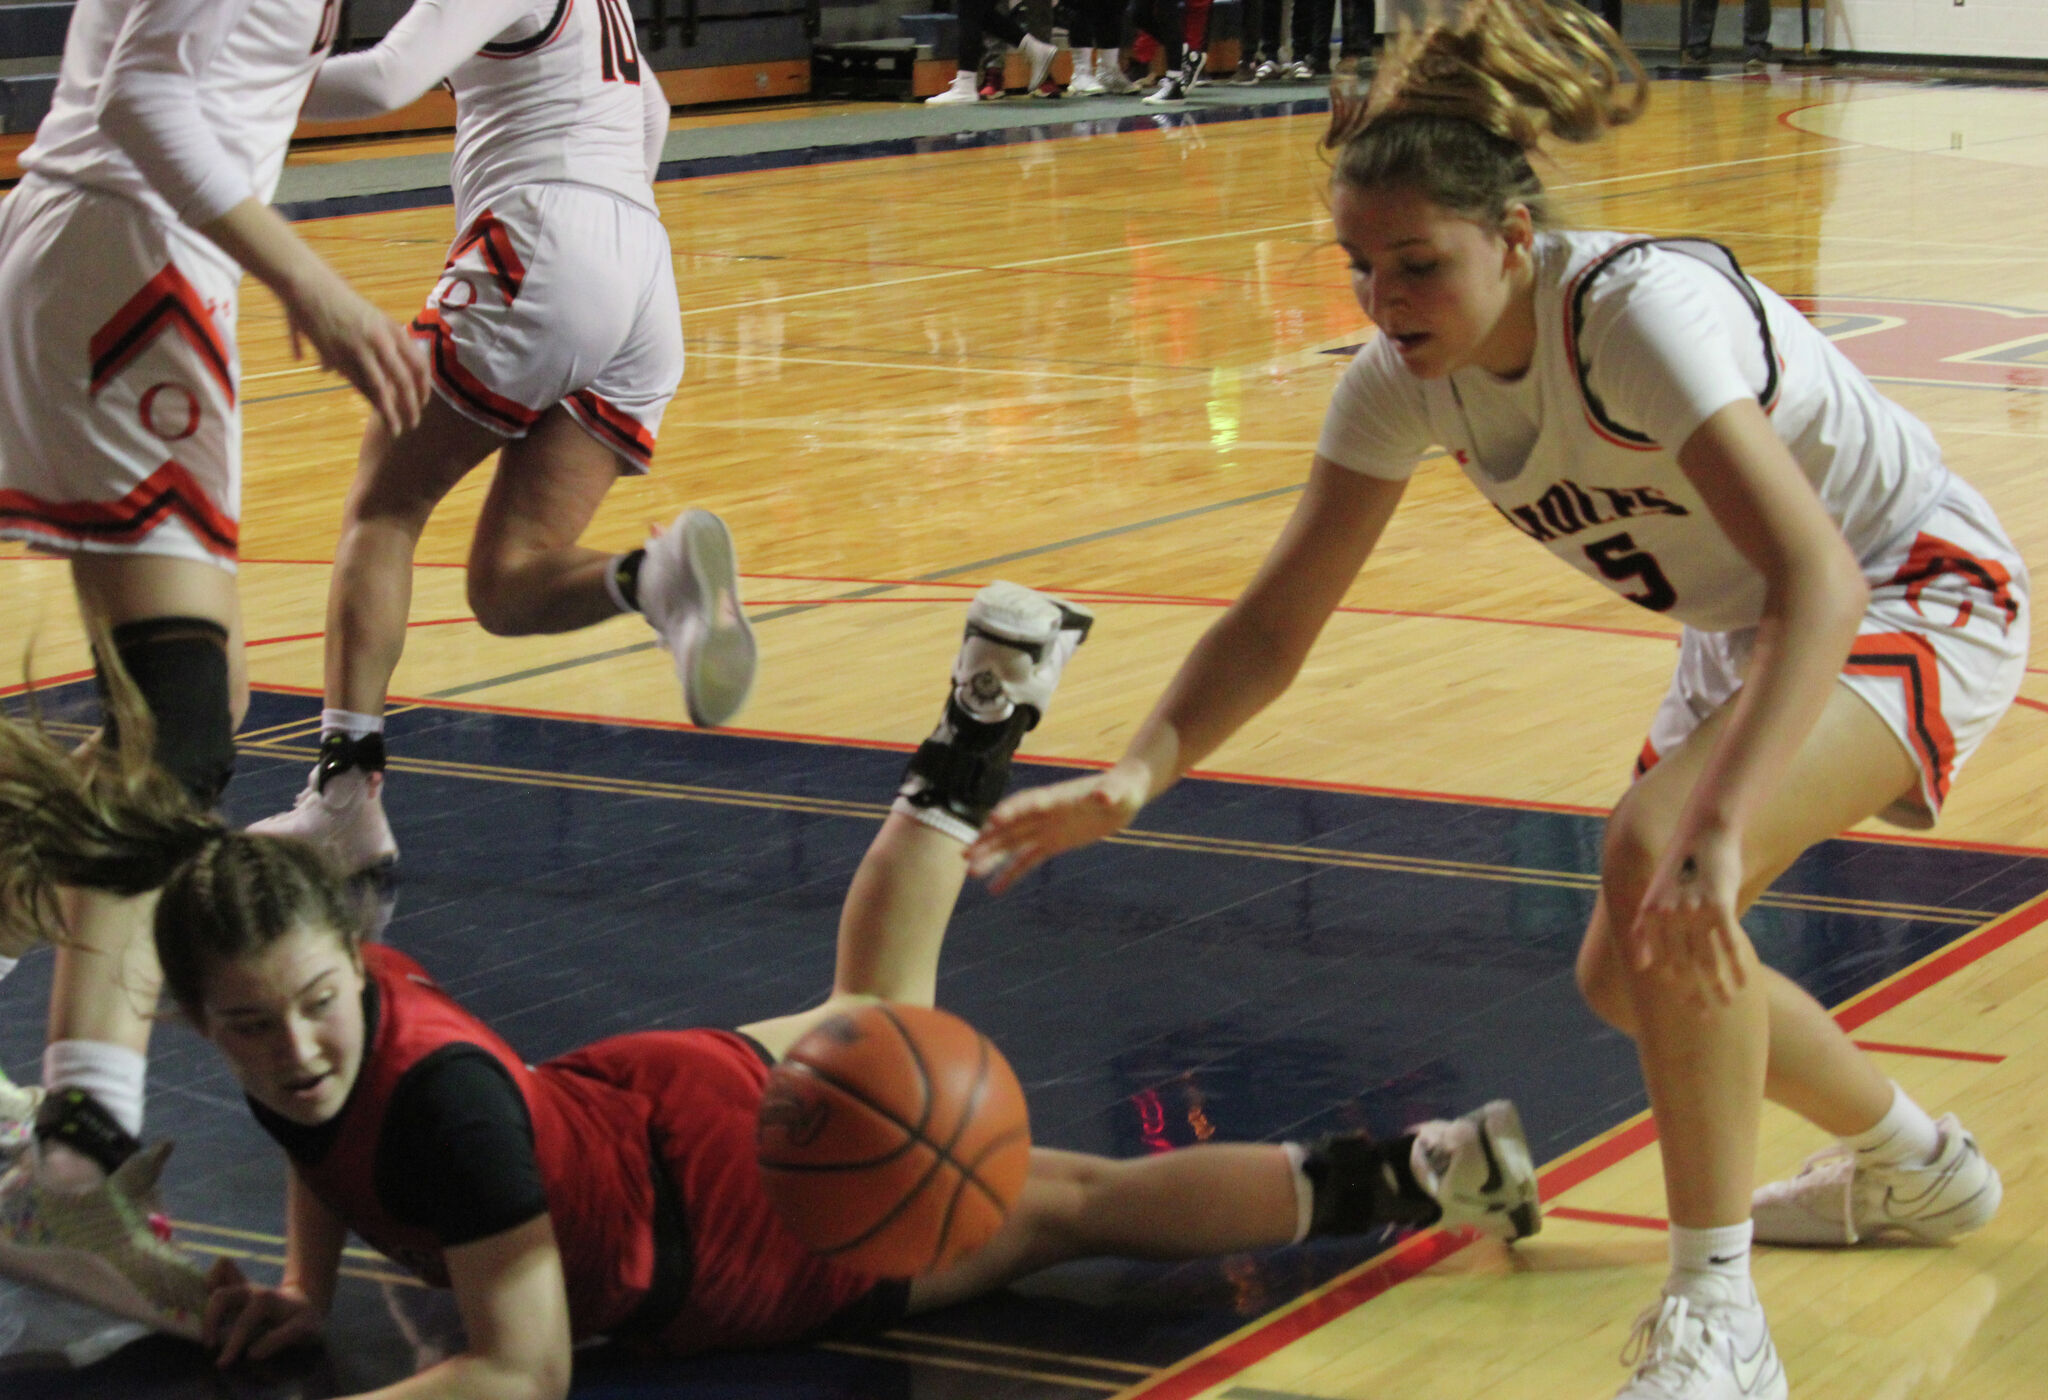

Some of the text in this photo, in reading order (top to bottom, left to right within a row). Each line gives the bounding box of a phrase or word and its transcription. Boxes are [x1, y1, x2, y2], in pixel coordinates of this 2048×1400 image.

[597, 0, 640, 86] 10
[139, 381, 200, 441] O
[1582, 531, 1677, 612] 5
